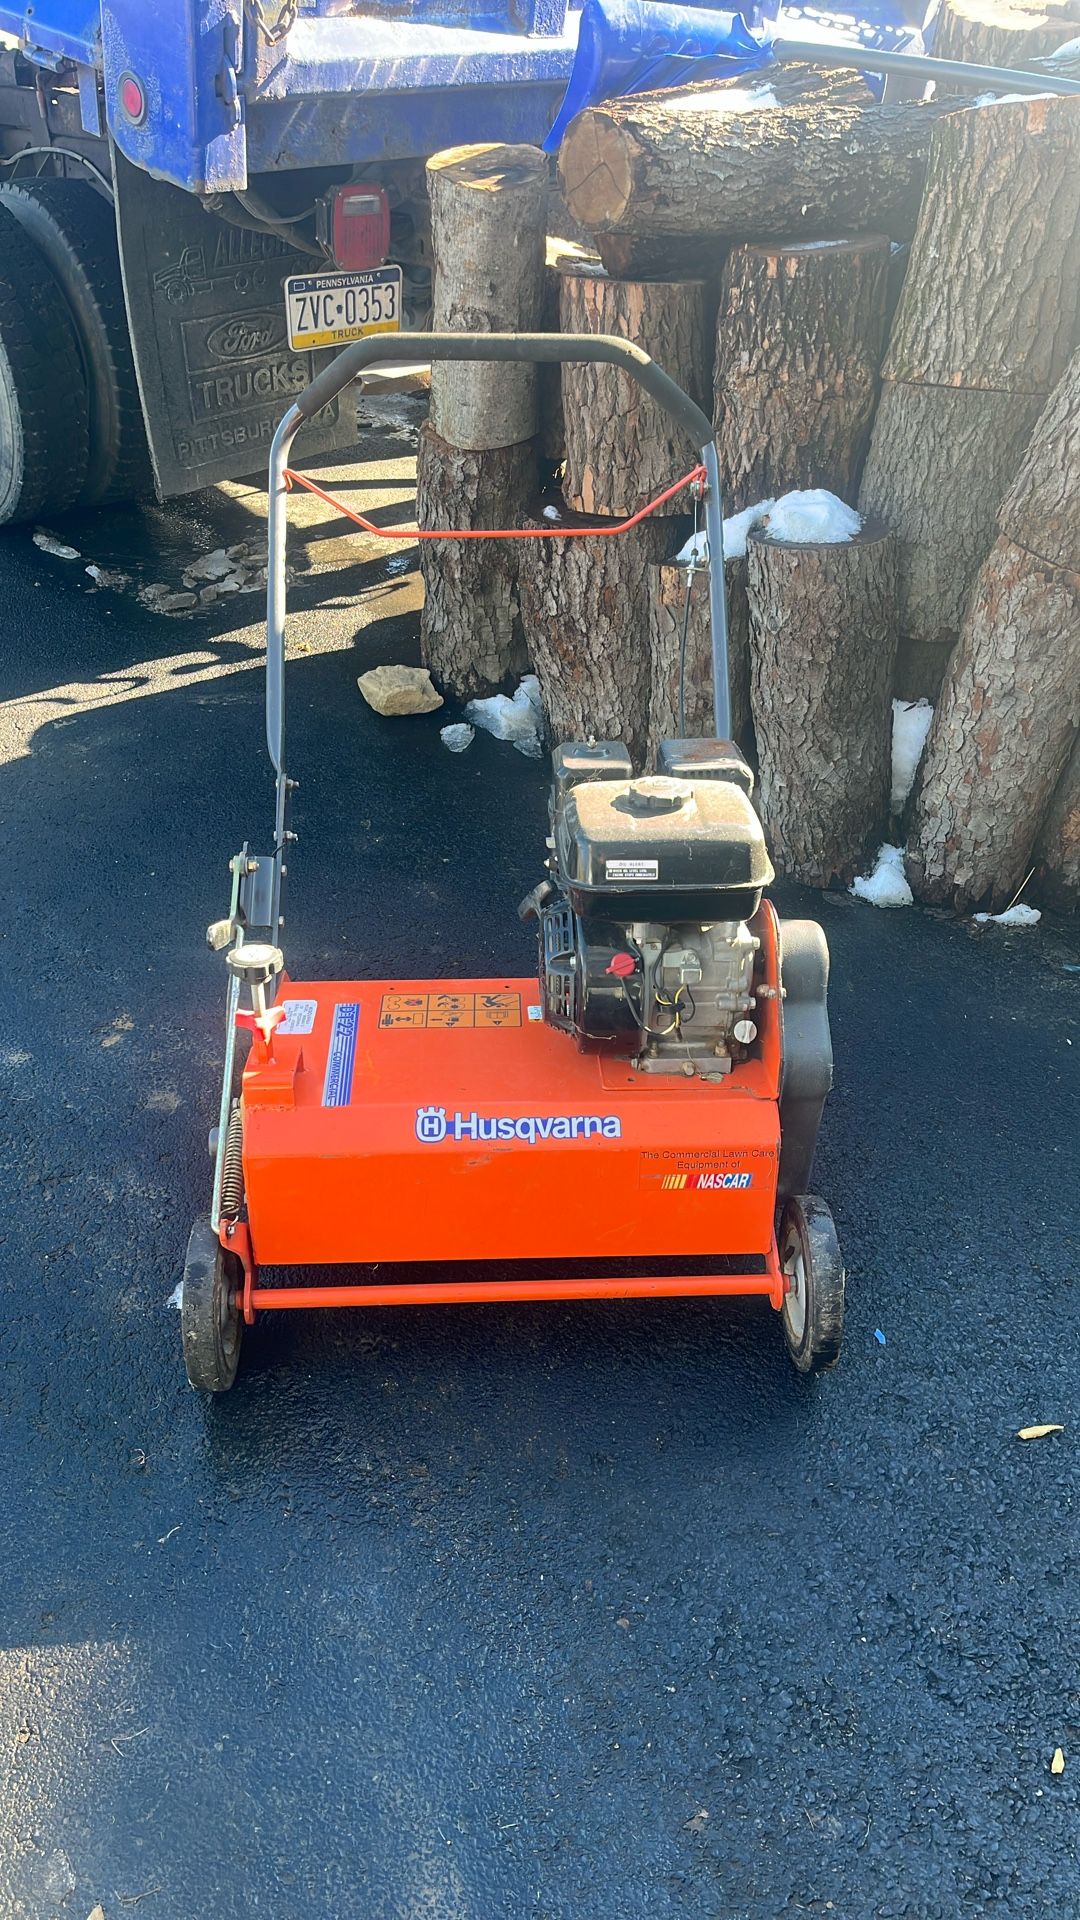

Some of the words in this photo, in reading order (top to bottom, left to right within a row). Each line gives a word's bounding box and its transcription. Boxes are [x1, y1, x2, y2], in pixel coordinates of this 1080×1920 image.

[316, 274, 374, 289] PENNSYLVANIA
[222, 320, 274, 350] Ford
[331, 327, 364, 340] TRUCK
[196, 359, 309, 408] TRUCKS
[328, 1051, 342, 1099] COMMERCIAL
[453, 1111, 622, 1144] Husqvarna
[641, 1150, 660, 1159] The
[662, 1149, 720, 1159] Commercial
[722, 1149, 748, 1158] Lawn
[751, 1148, 775, 1158] Care
[677, 1160, 729, 1170] Equipment
[730, 1159, 741, 1169] of
[696, 1173, 751, 1189] NASCAR
